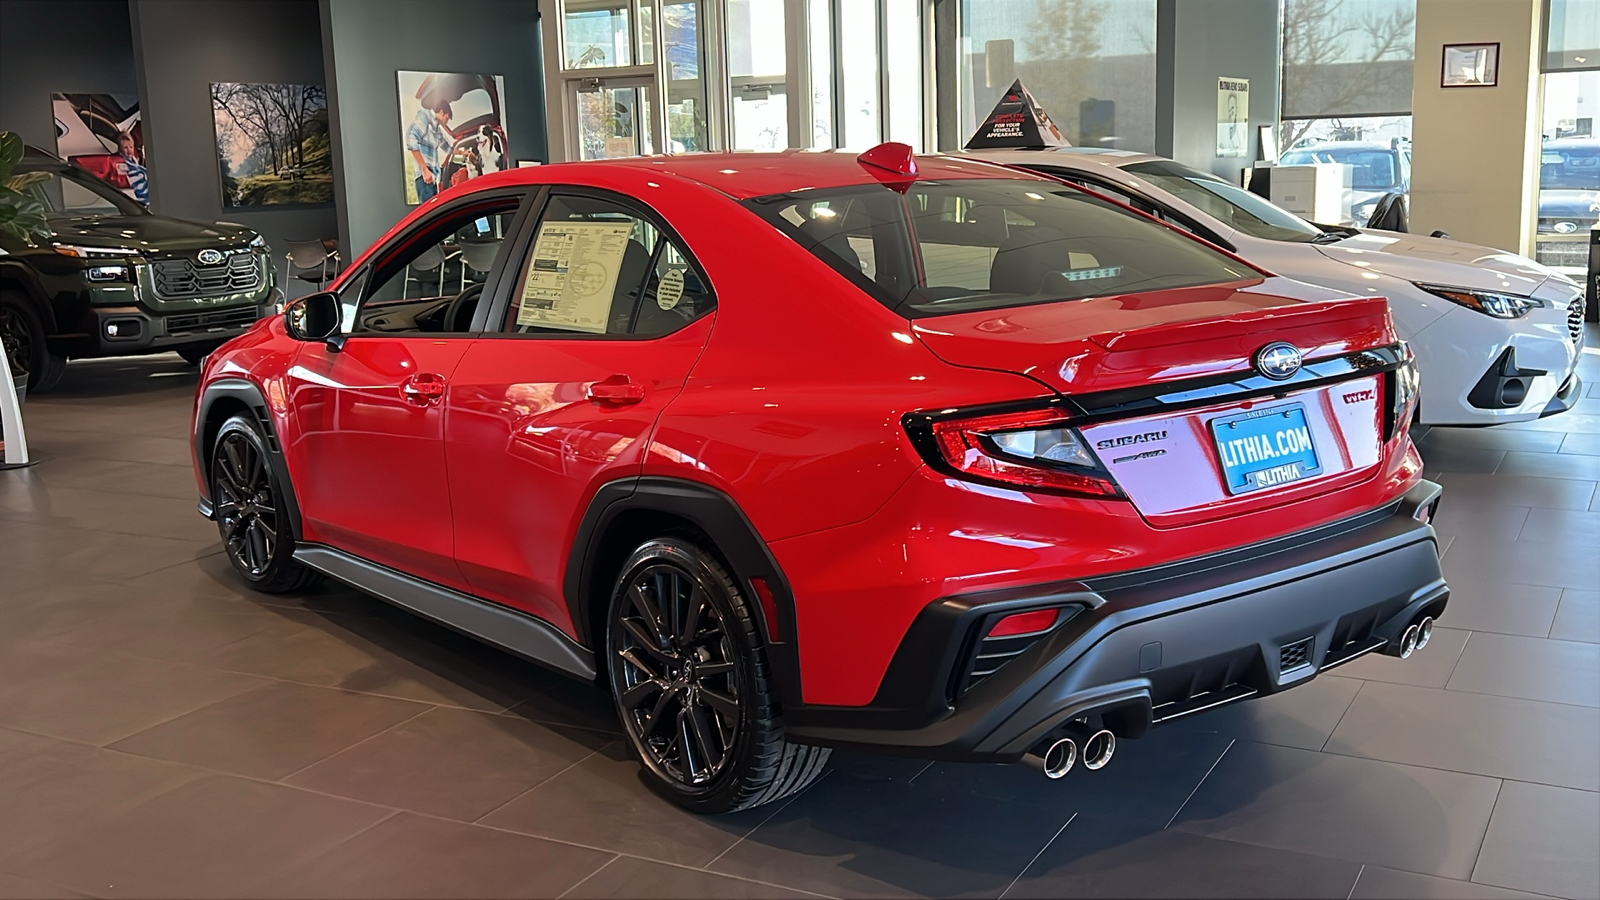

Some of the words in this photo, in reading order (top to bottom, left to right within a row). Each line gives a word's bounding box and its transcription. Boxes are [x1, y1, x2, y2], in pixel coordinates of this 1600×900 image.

[1342, 389, 1375, 404] WRX
[1097, 430, 1168, 450] SUBARU
[1220, 426, 1312, 467] LITHIA.COM
[1136, 449, 1167, 459] AWD
[1266, 464, 1301, 486] LITHIA
